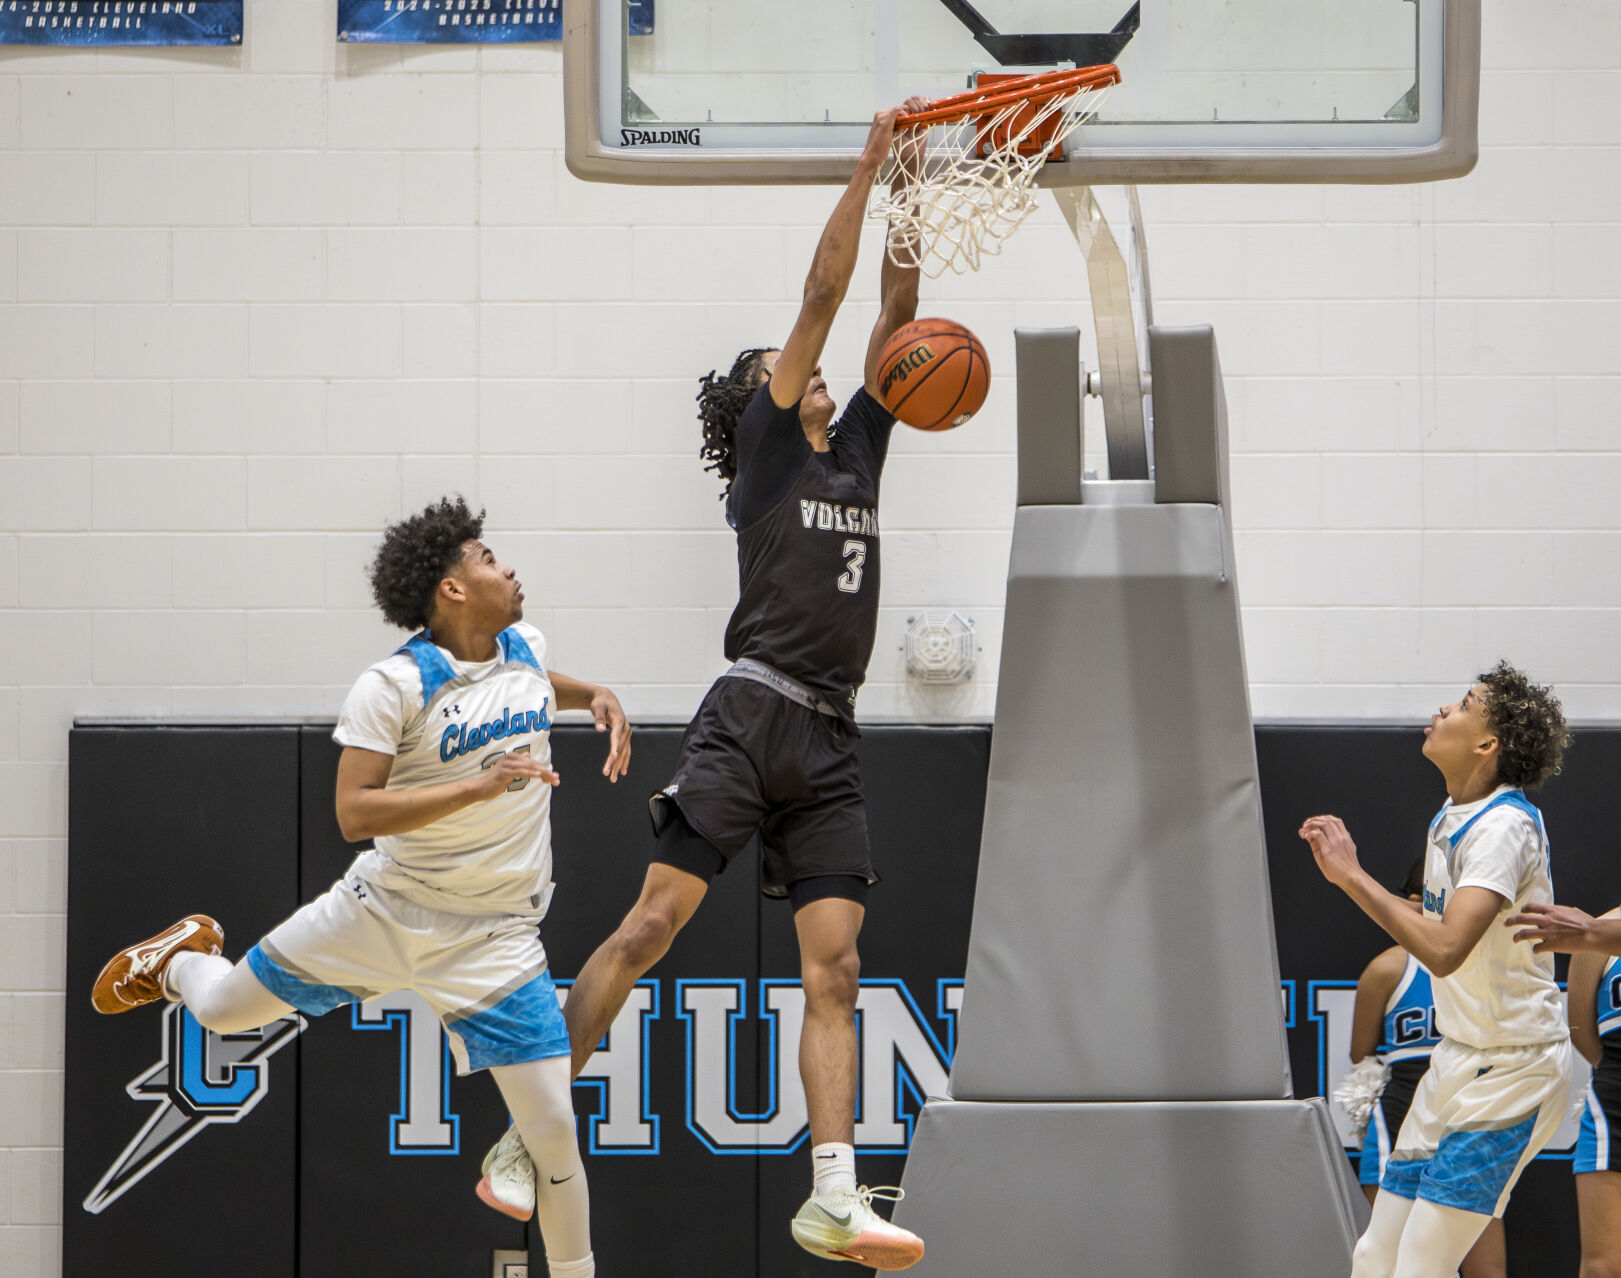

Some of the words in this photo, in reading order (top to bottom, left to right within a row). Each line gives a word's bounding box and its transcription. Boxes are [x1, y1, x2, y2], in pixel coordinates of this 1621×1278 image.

[93, 1, 196, 14] CLEVELAND
[505, 0, 559, 9] CLEVE
[25, 16, 142, 28] BASKETBALL
[438, 12, 555, 26] BASKETBALL
[621, 128, 700, 147] SPALDING
[837, 539, 867, 593] 3
[439, 696, 551, 763] Cleveland
